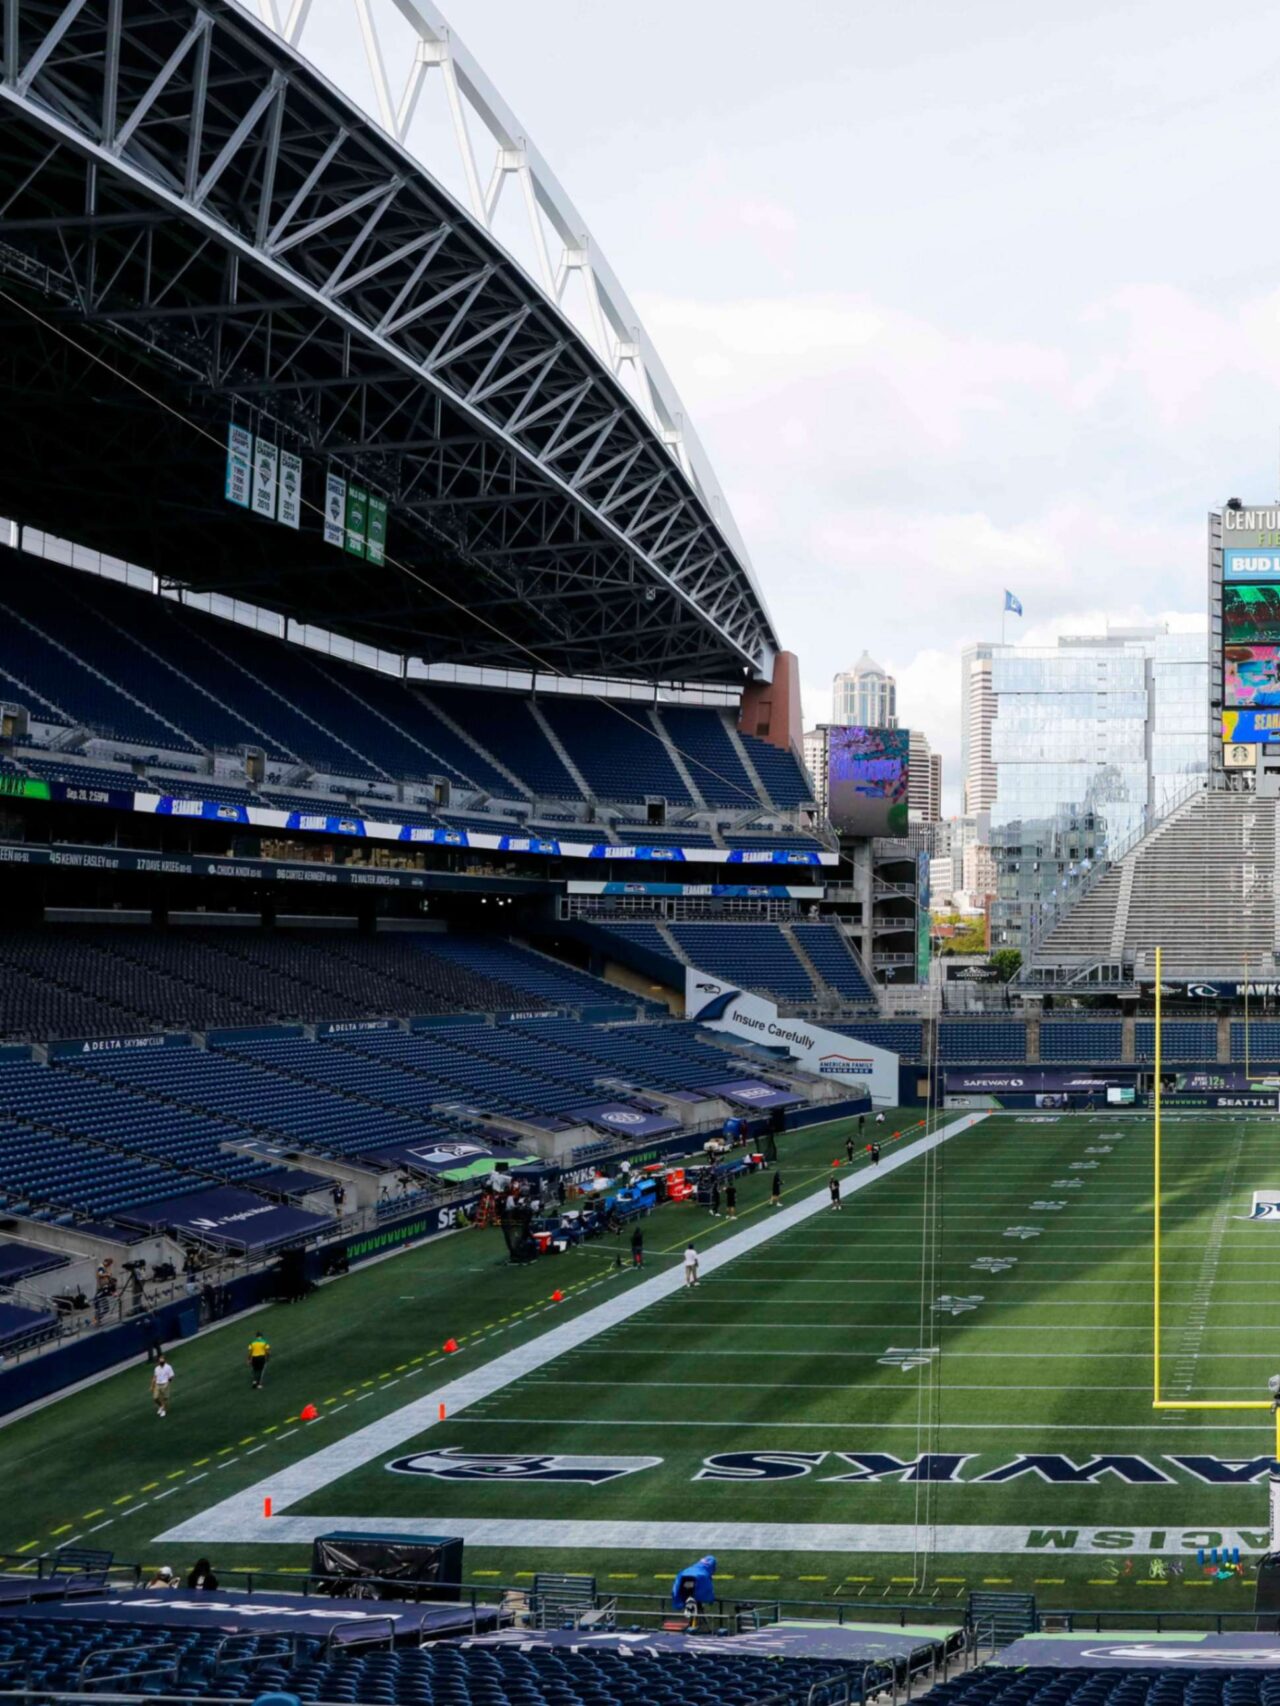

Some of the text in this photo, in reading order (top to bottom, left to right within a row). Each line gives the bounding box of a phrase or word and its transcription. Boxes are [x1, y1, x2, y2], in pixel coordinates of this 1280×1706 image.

[1232, 557, 1271, 572] BUD
[50, 852, 61, 864] 45
[61, 853, 83, 866] KENNY
[84, 854, 106, 868] EASLEY
[137, 859, 145, 870] 17
[335, 1023, 357, 1032] DELTA
[732, 1010, 815, 1050] Insure Carefully
[92, 1040, 121, 1050] DELTA
[1217, 1097, 1275, 1106] SEATTLE
[969, 1256, 1018, 1270] 30
[929, 1295, 985, 1311] 20
[876, 1347, 940, 1365] 10
